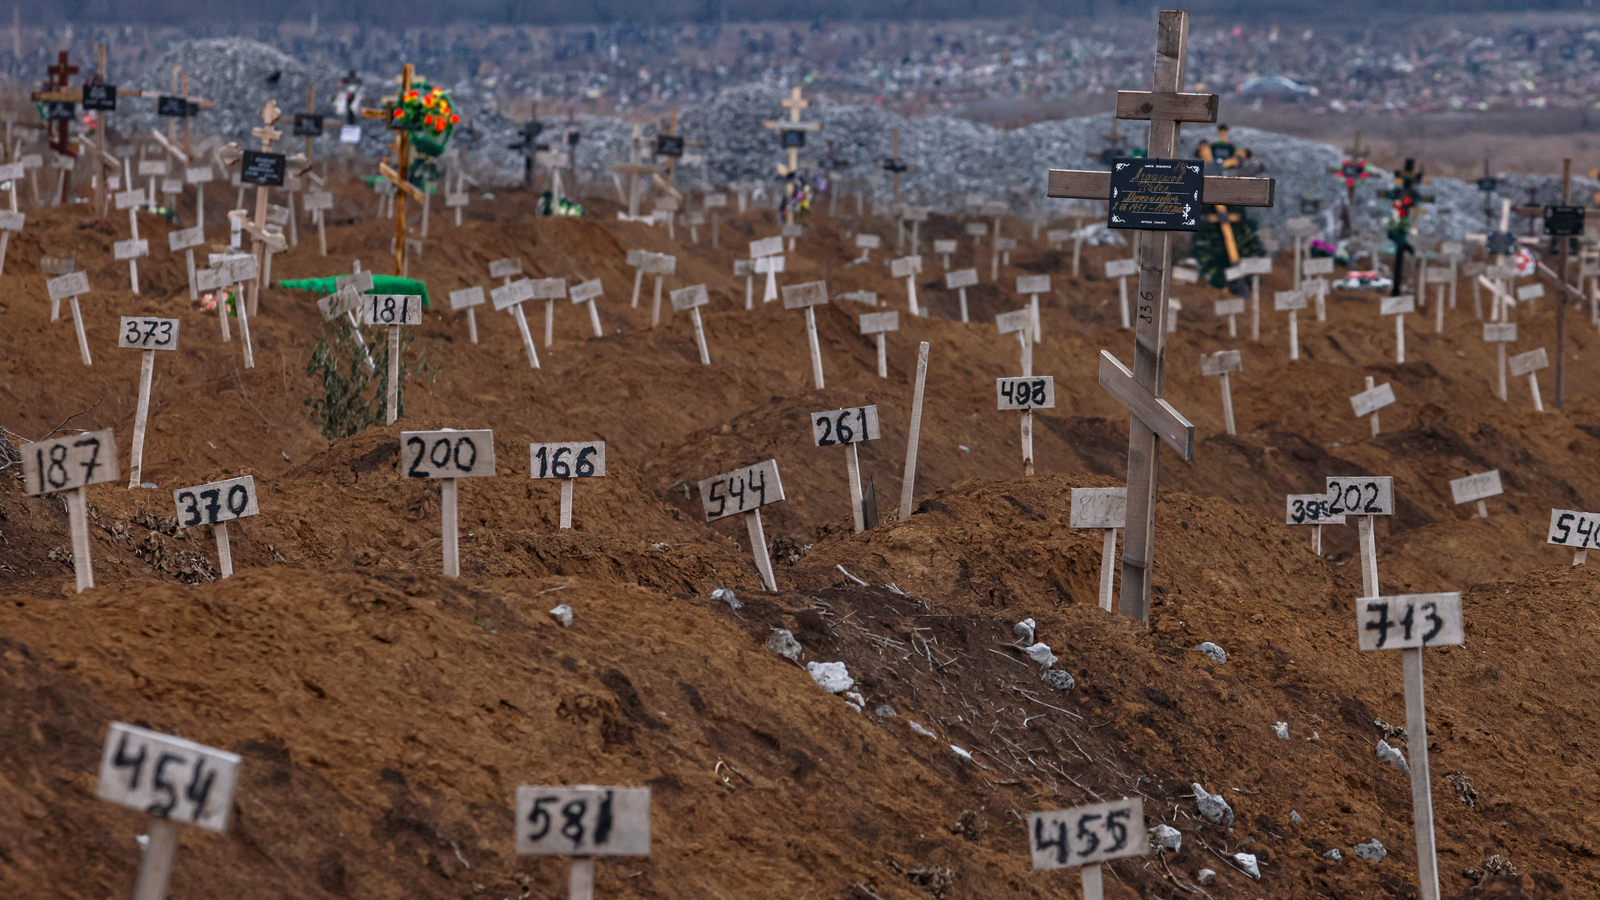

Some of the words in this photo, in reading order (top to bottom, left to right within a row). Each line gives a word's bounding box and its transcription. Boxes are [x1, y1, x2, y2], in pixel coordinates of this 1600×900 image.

[371, 295, 411, 324] 181
[1138, 291, 1154, 325] 836
[125, 320, 173, 346] 373
[815, 407, 869, 447] 261
[36, 437, 102, 492] 187
[406, 436, 477, 478] 200
[535, 445, 598, 479] 166
[178, 483, 249, 526] 370
[706, 469, 765, 517] 544
[1328, 480, 1384, 515] 202
[1364, 601, 1444, 648] 713
[112, 730, 218, 823] 454
[527, 789, 614, 850] 581
[1035, 806, 1132, 865] 455
